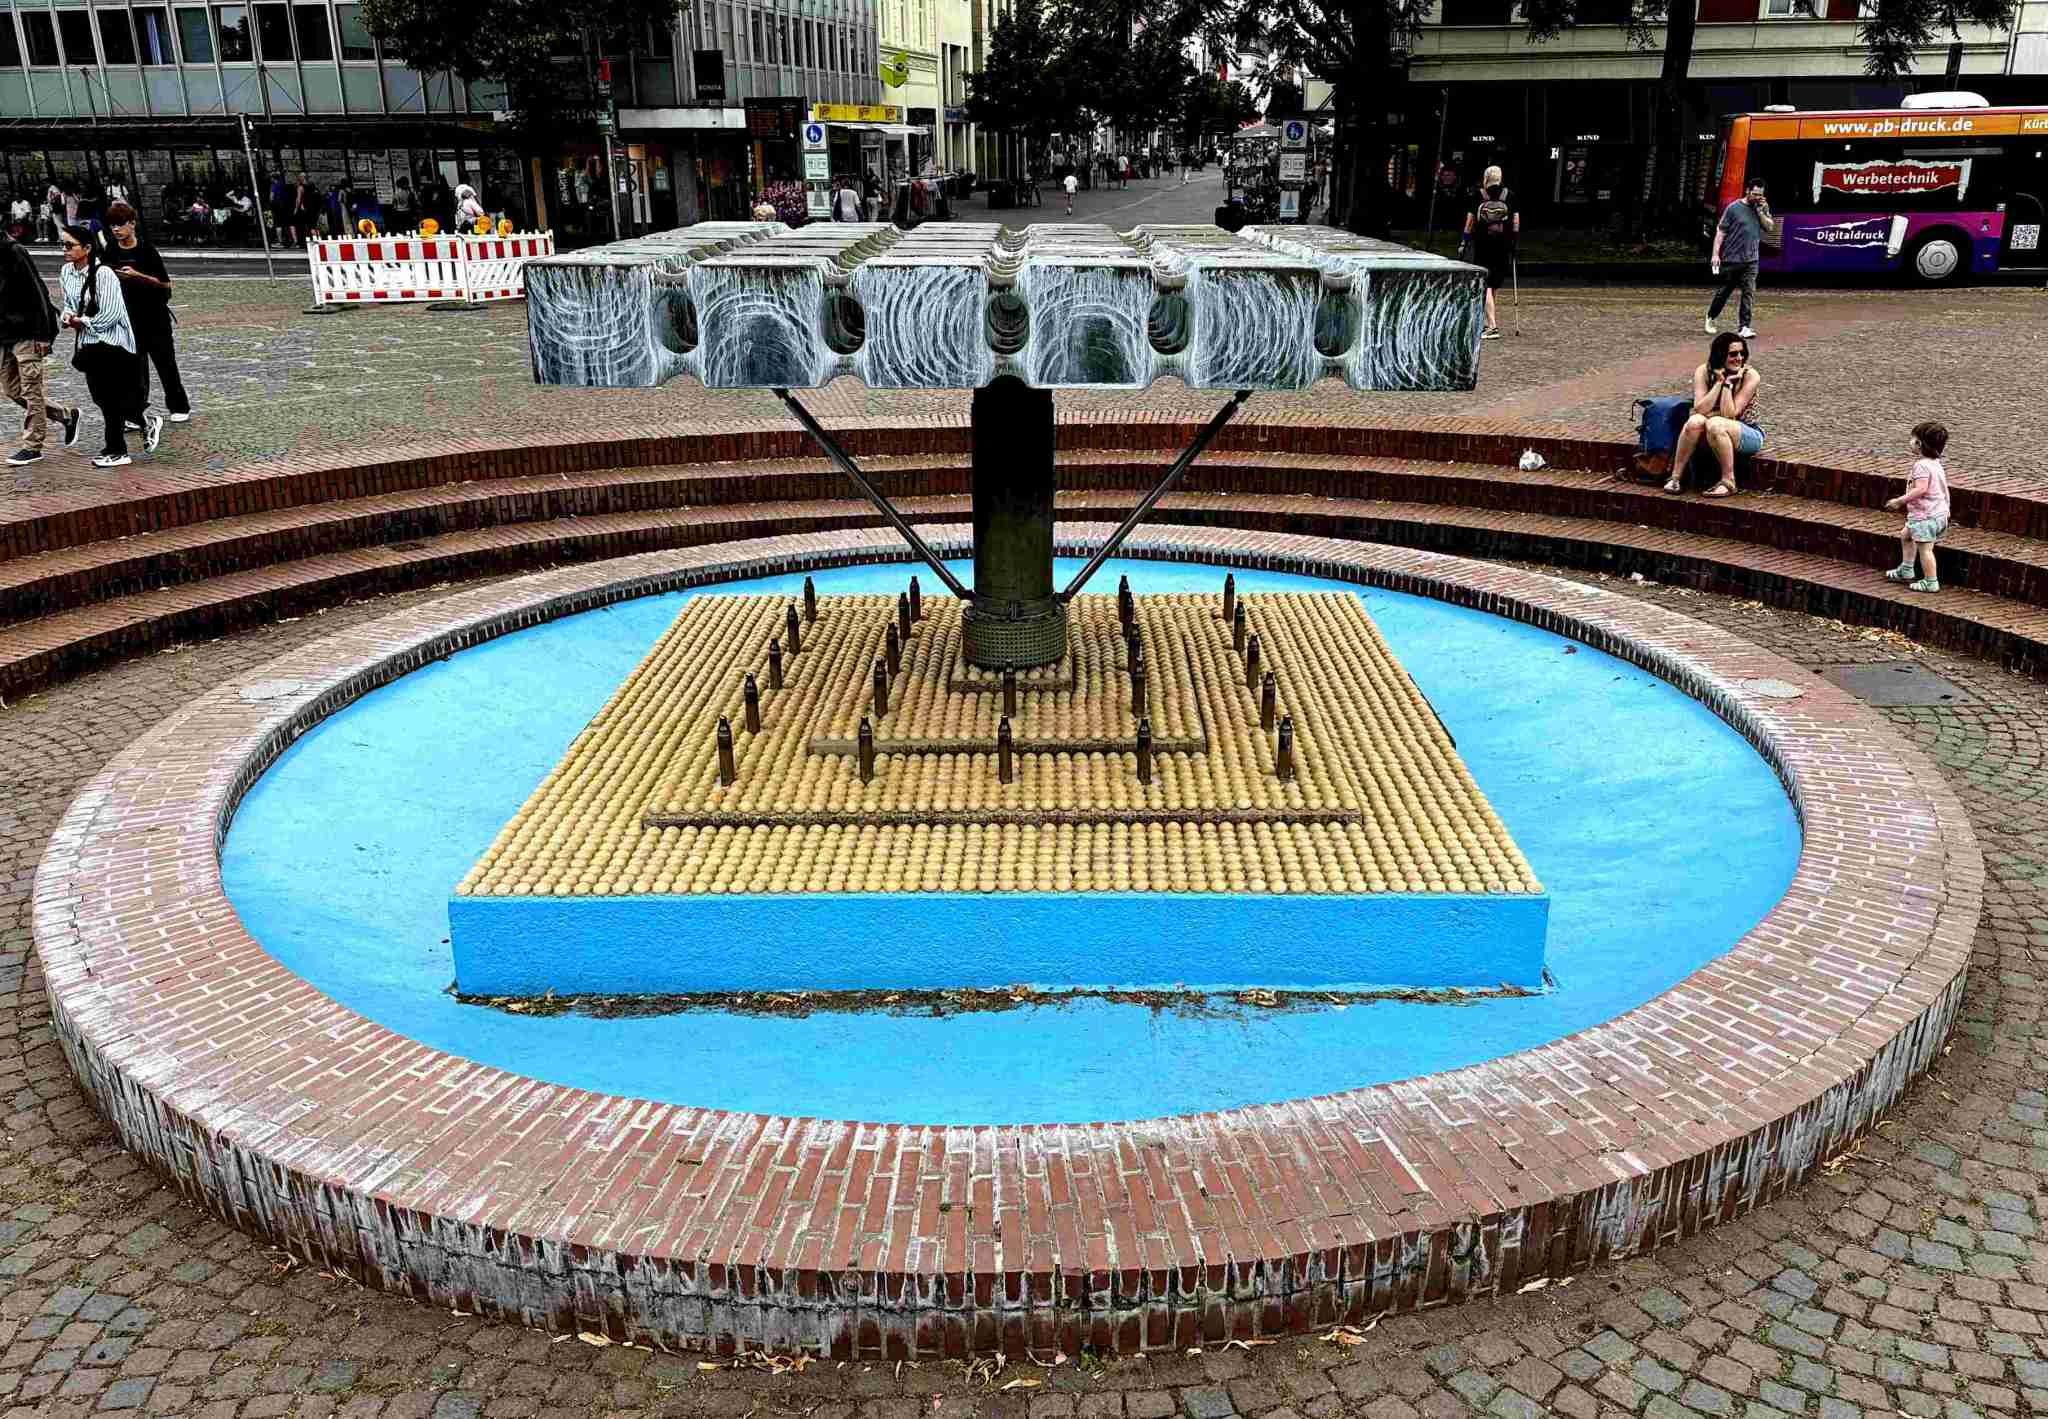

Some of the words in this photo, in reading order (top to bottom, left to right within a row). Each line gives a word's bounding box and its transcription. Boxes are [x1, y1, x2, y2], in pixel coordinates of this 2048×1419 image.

[1824, 117, 1973, 137] www.pb-druck.de
[1577, 134, 1600, 142] KIND
[1842, 171, 1939, 185] Werbetechnik
[1817, 230, 1885, 242] Digitaldruck
